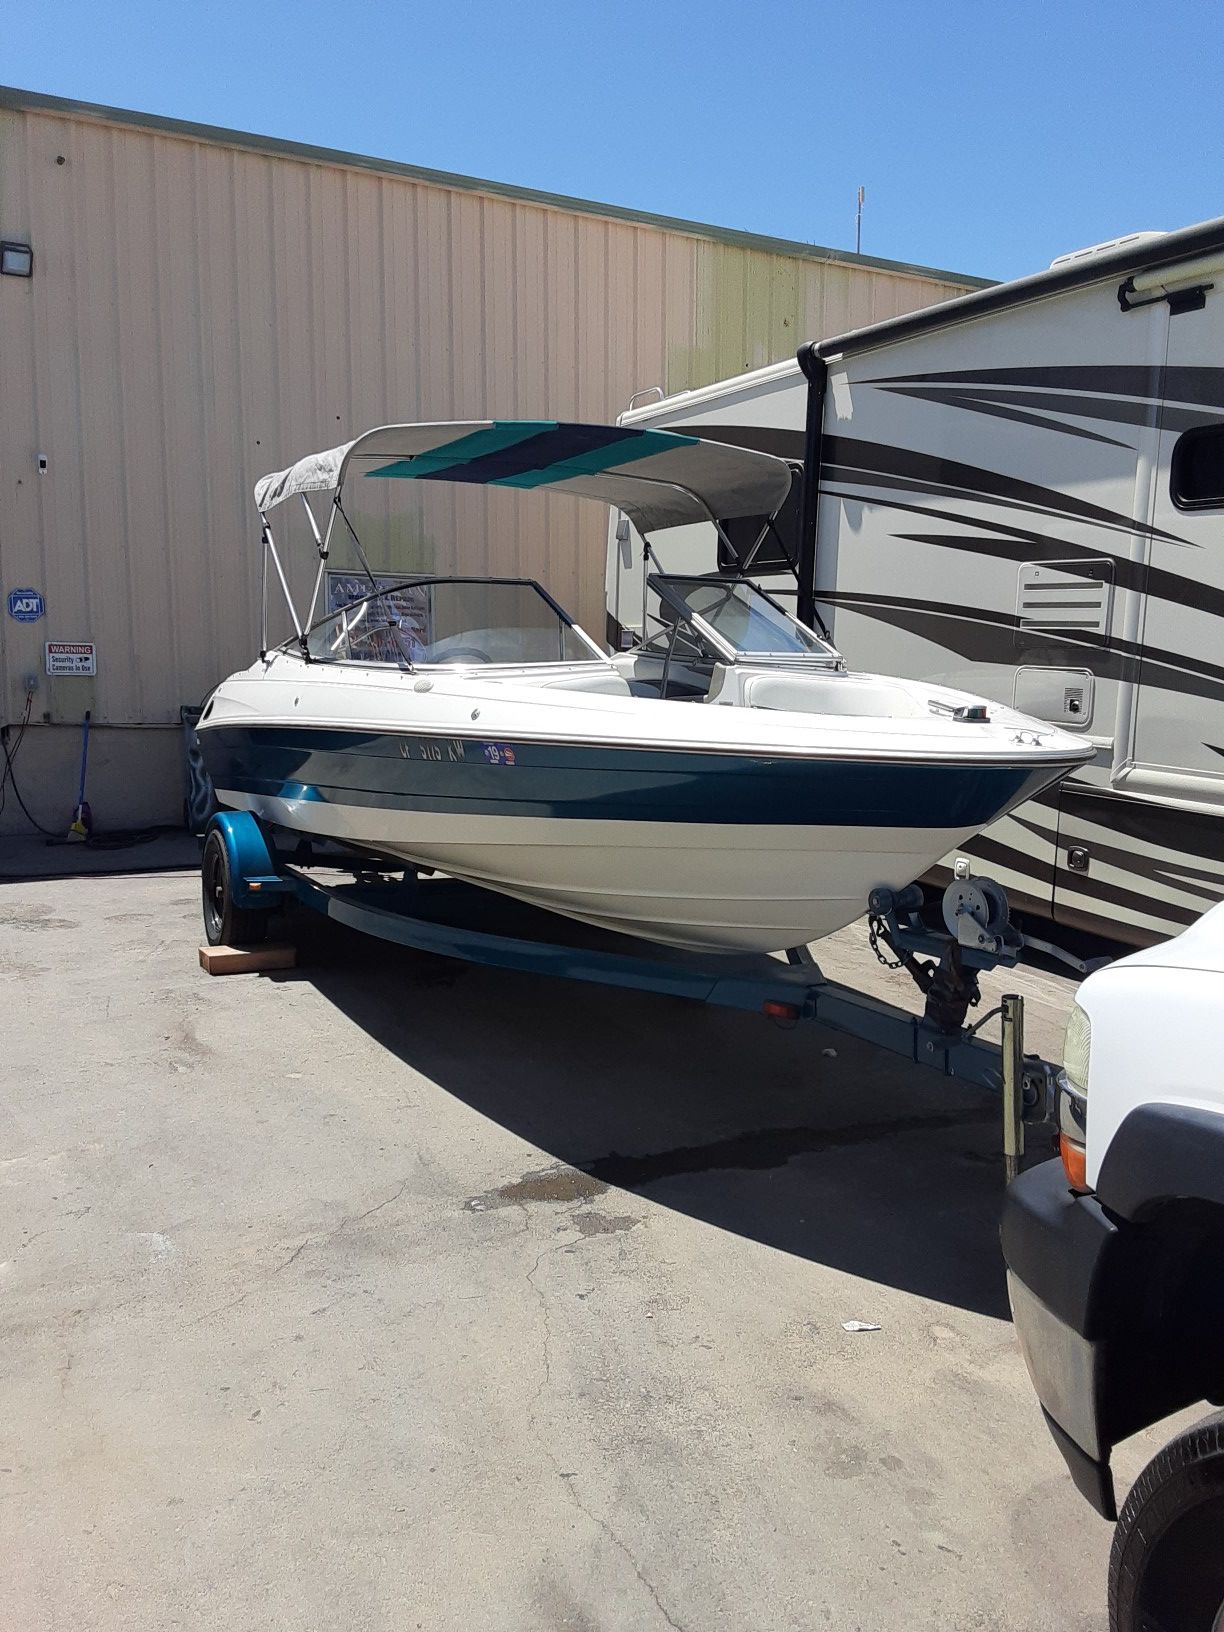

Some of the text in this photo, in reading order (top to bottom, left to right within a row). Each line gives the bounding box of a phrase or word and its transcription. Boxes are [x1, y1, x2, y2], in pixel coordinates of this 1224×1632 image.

[14, 598, 39, 611] ADT
[51, 656, 74, 664] Security
[487, 745, 500, 761] 19
